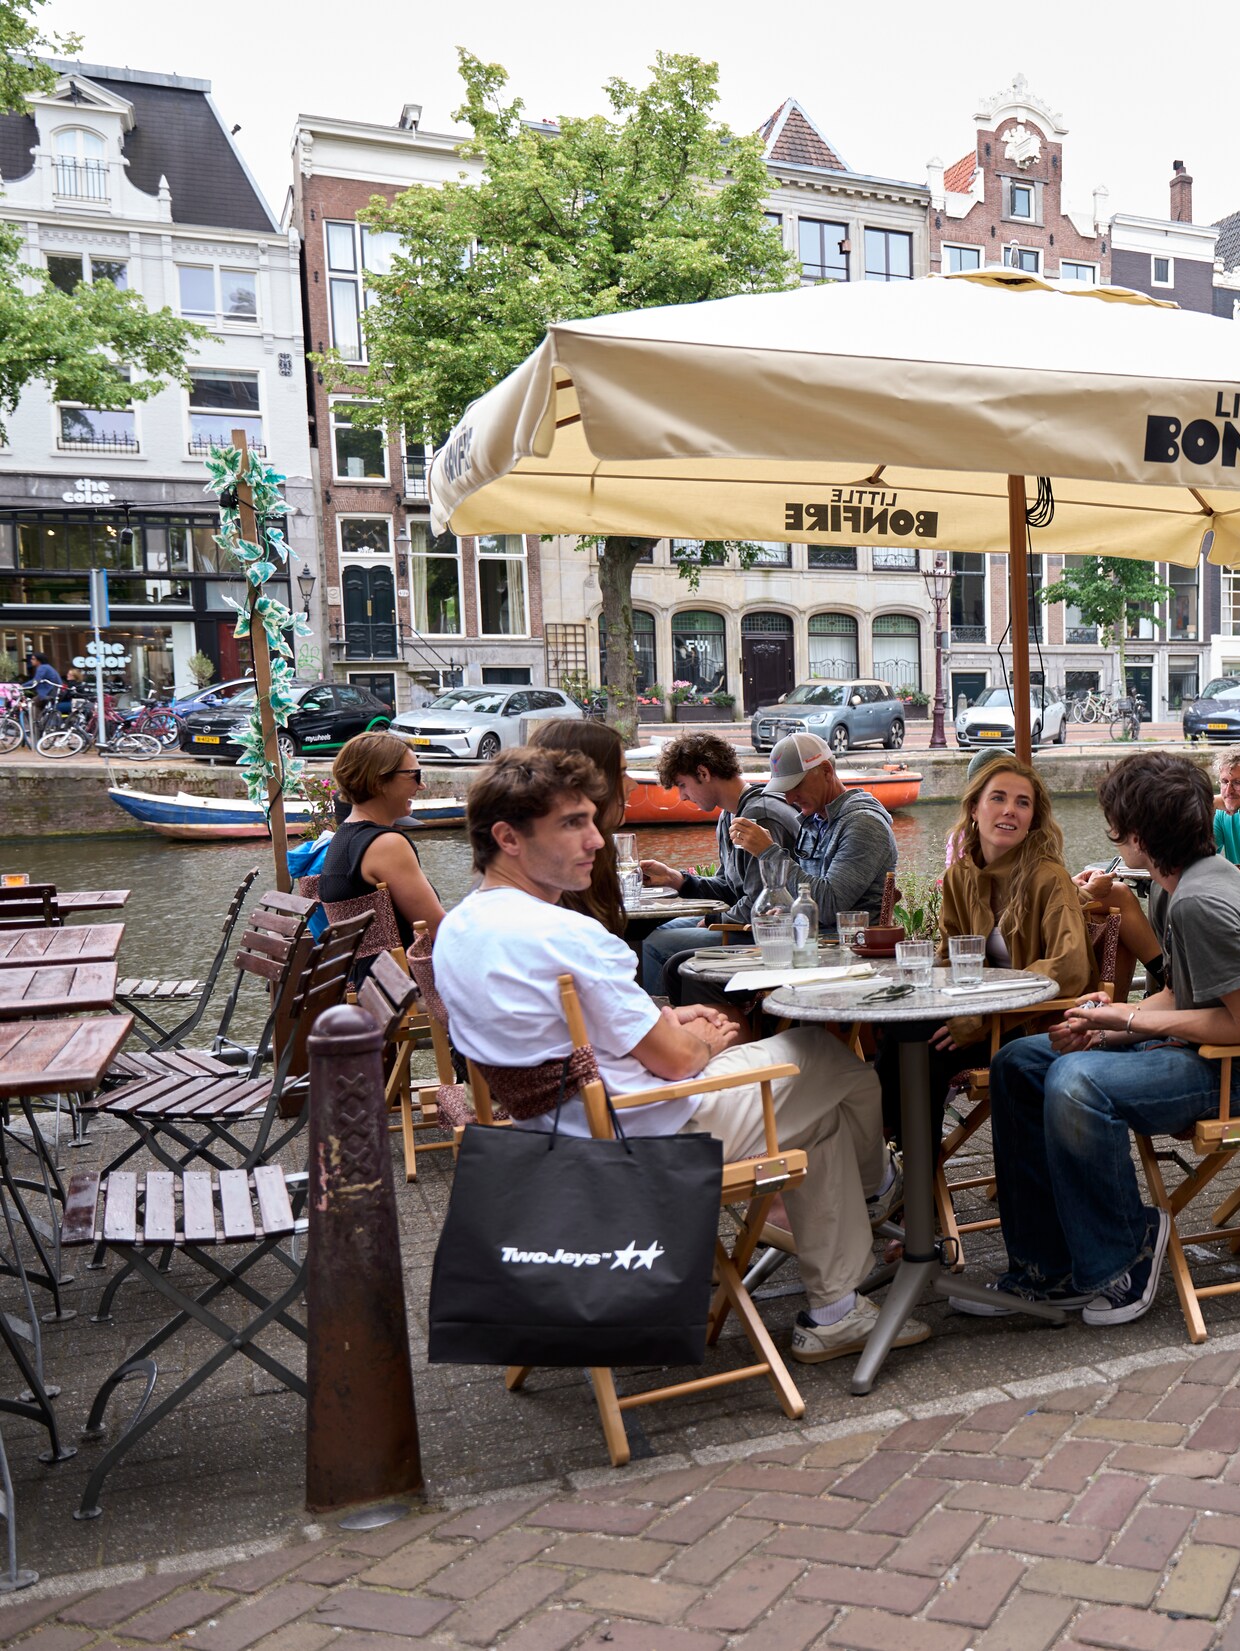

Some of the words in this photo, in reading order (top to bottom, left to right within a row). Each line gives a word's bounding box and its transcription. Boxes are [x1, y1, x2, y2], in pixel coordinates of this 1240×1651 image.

[74, 478, 110, 492] the
[62, 491, 116, 504] color
[86, 641, 125, 654] the
[72, 655, 132, 668] color
